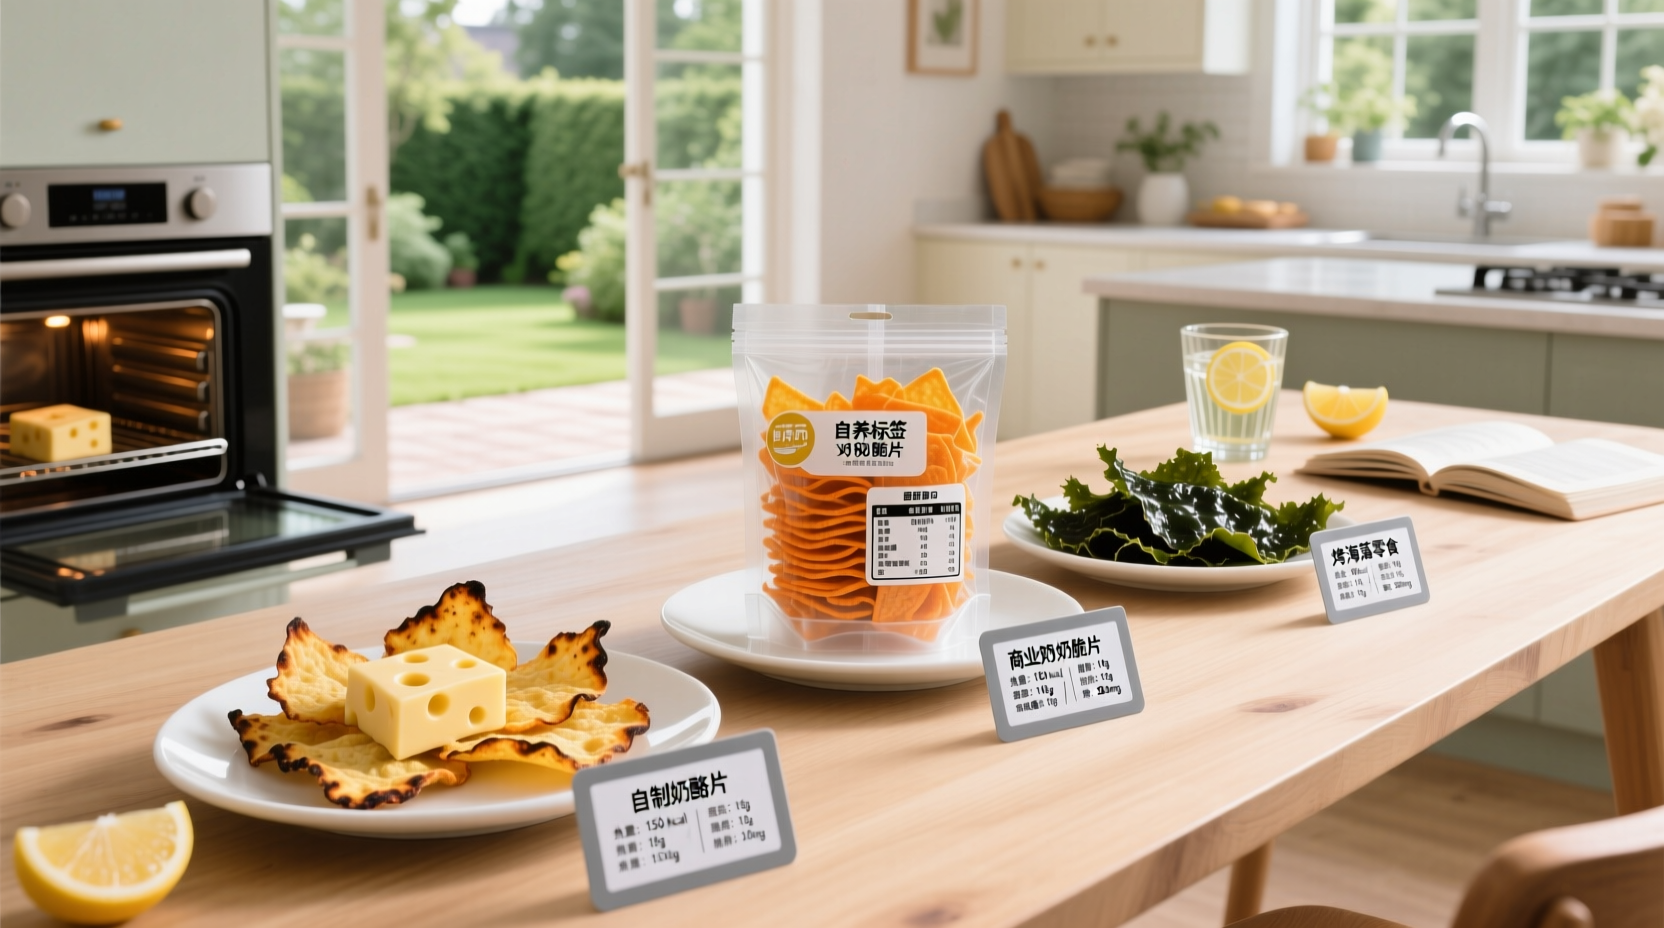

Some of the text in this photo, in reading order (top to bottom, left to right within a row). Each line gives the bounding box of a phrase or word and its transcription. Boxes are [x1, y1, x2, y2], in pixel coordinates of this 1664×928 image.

[631, 770, 728, 813] 自制奶酪片
